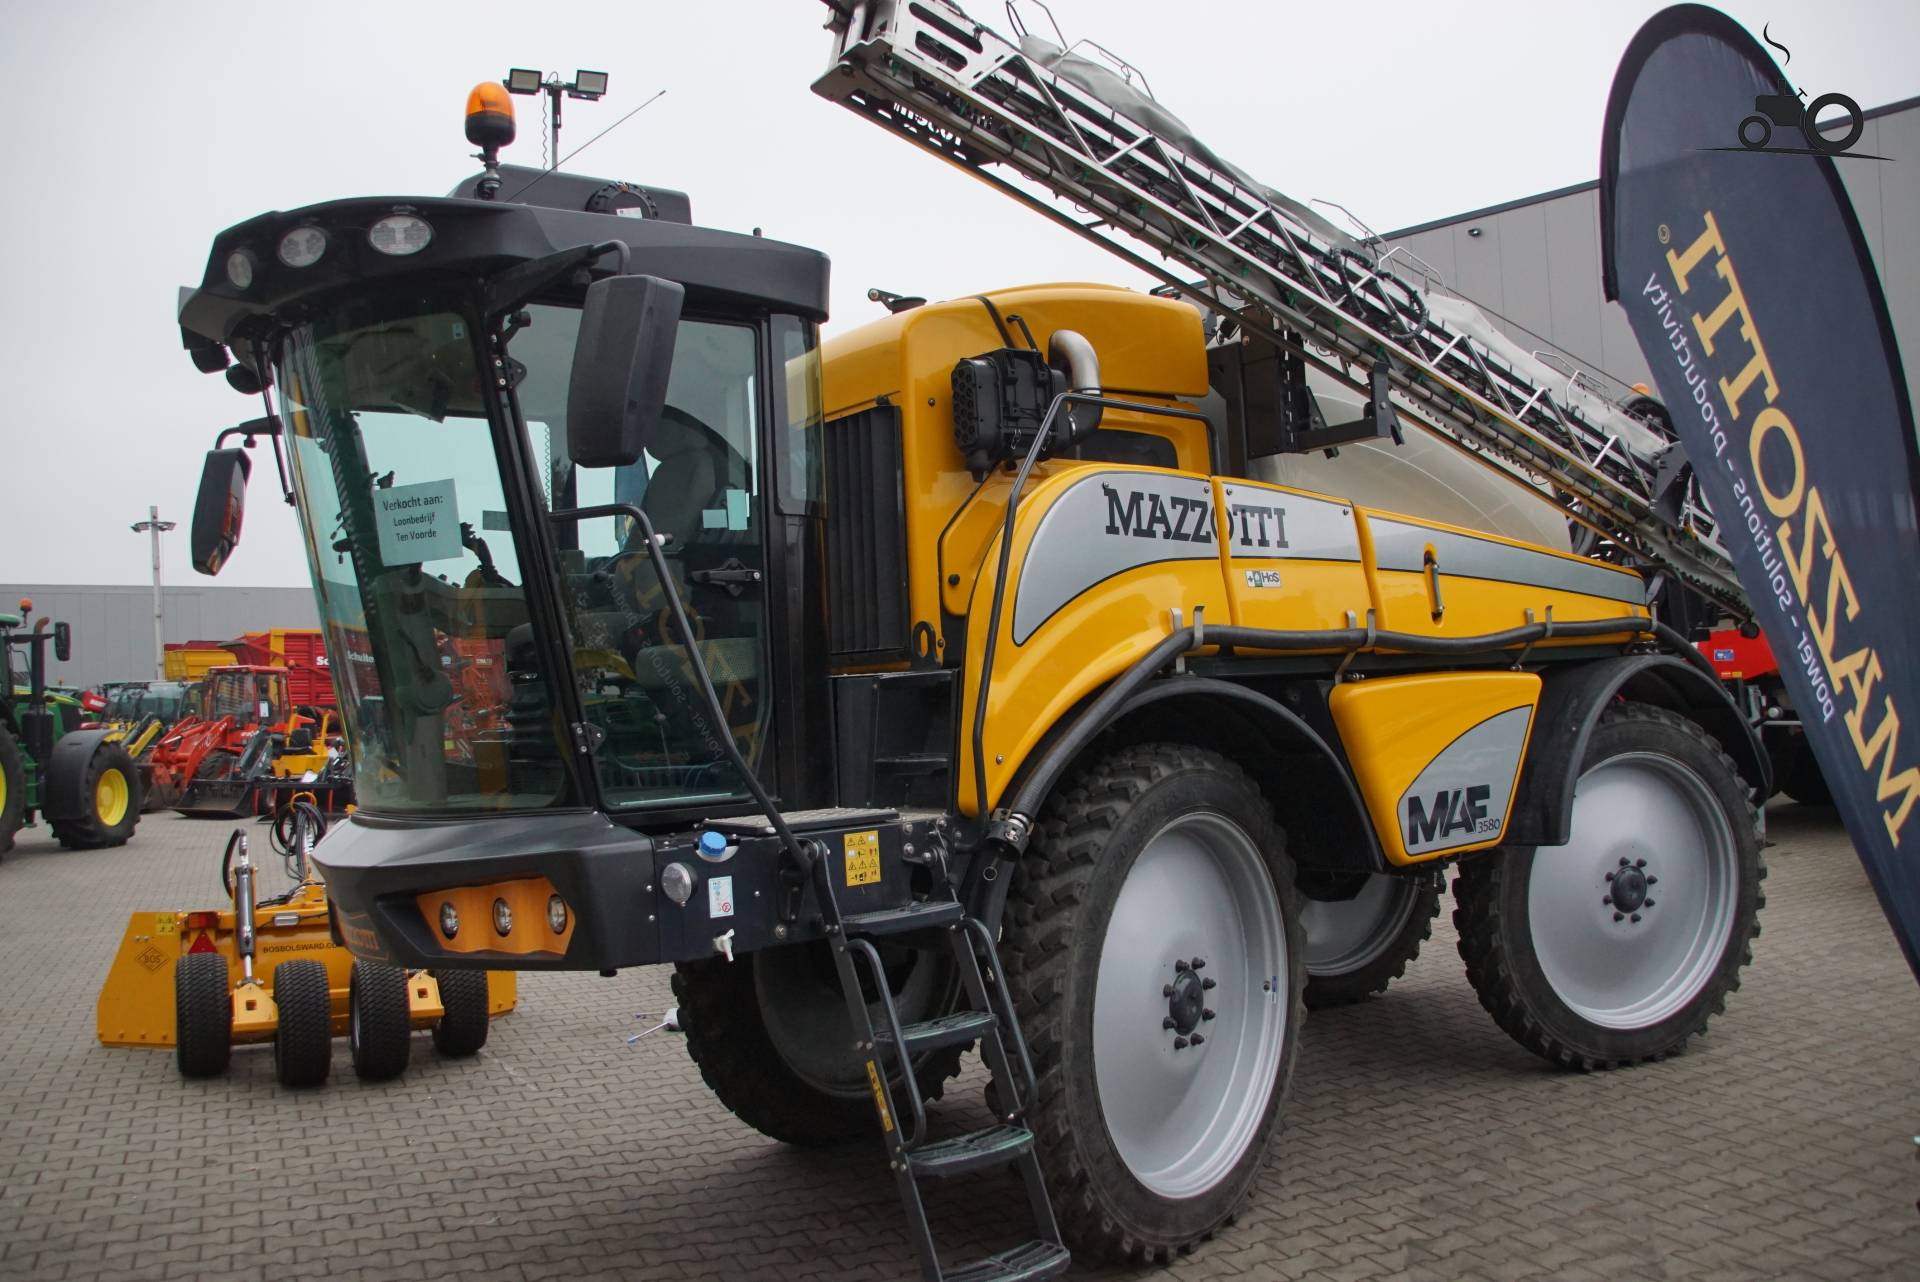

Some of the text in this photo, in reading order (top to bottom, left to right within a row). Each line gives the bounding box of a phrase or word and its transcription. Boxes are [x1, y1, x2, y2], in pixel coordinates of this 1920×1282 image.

[383, 495, 444, 511] Verkocht aan:
[393, 512, 435, 526] Loonbedrijf
[396, 528, 437, 542] Ten Voorde
[1408, 784, 1490, 845] MAF
[1477, 818, 1500, 834] 3580
